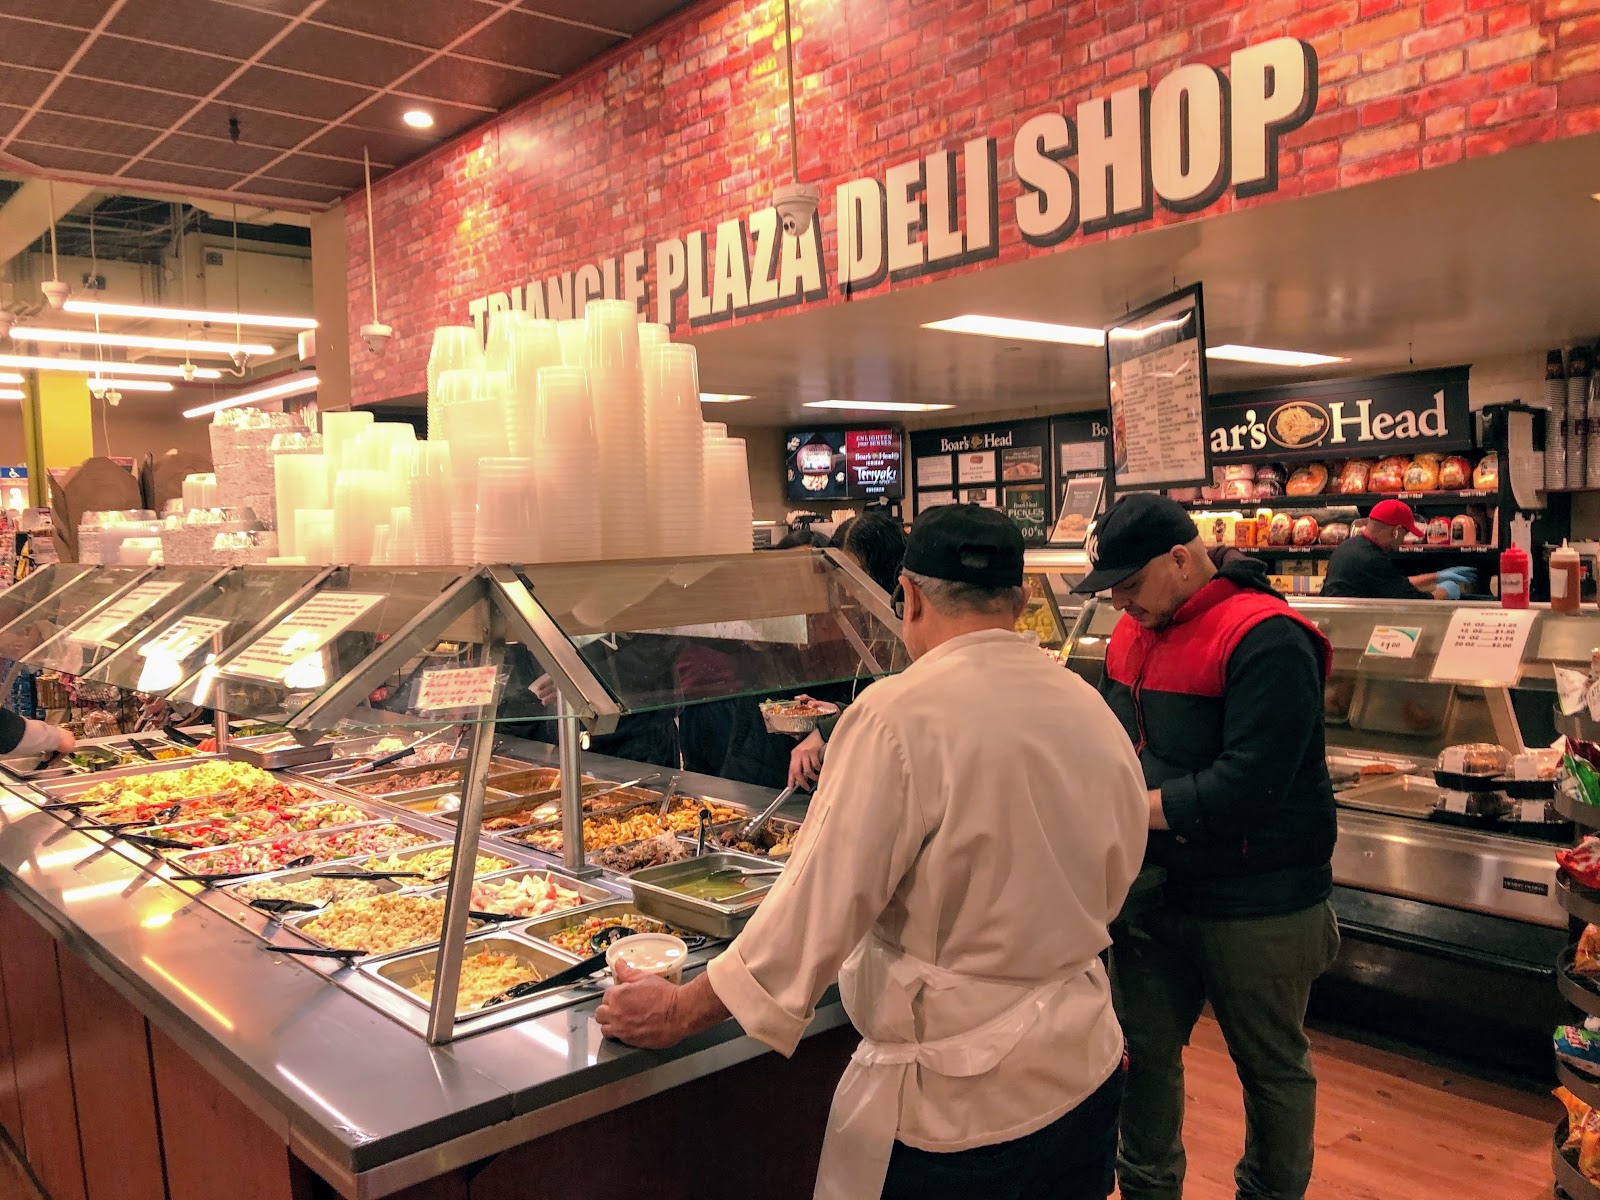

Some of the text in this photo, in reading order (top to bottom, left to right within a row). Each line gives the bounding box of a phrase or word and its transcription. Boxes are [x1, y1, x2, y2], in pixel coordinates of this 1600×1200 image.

[656, 206, 824, 324] PLAZA
[837, 136, 990, 286] DELI
[1013, 37, 1308, 238] SHOP
[1210, 389, 1449, 453] ar's Head
[941, 431, 1012, 452] Boar's Head
[852, 466, 897, 485] Teriyaki
[1008, 508, 1045, 518] PICKLES
